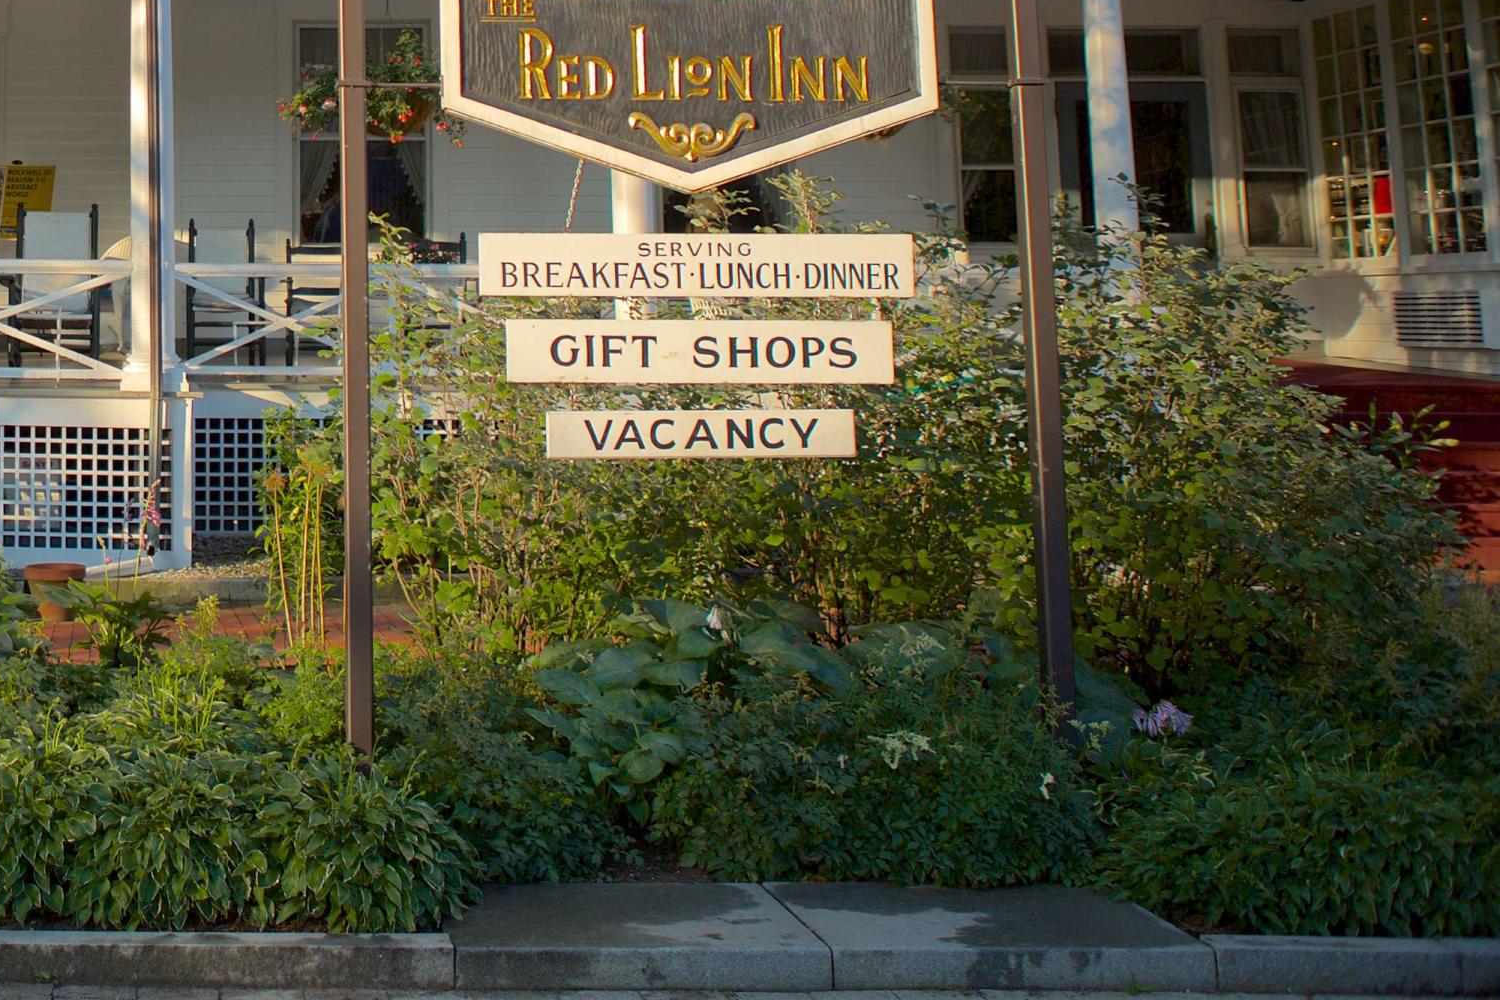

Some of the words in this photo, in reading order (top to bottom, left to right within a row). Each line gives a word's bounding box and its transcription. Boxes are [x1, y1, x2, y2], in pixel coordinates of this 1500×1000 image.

[638, 242, 752, 257] SERVING
[501, 262, 685, 289] BREAKFAST
[700, 263, 792, 289] LUNCH
[805, 263, 899, 290] DINNER
[550, 335, 658, 368] GIFT
[693, 336, 858, 368] SHOPS
[584, 417, 819, 450] VACANCY
